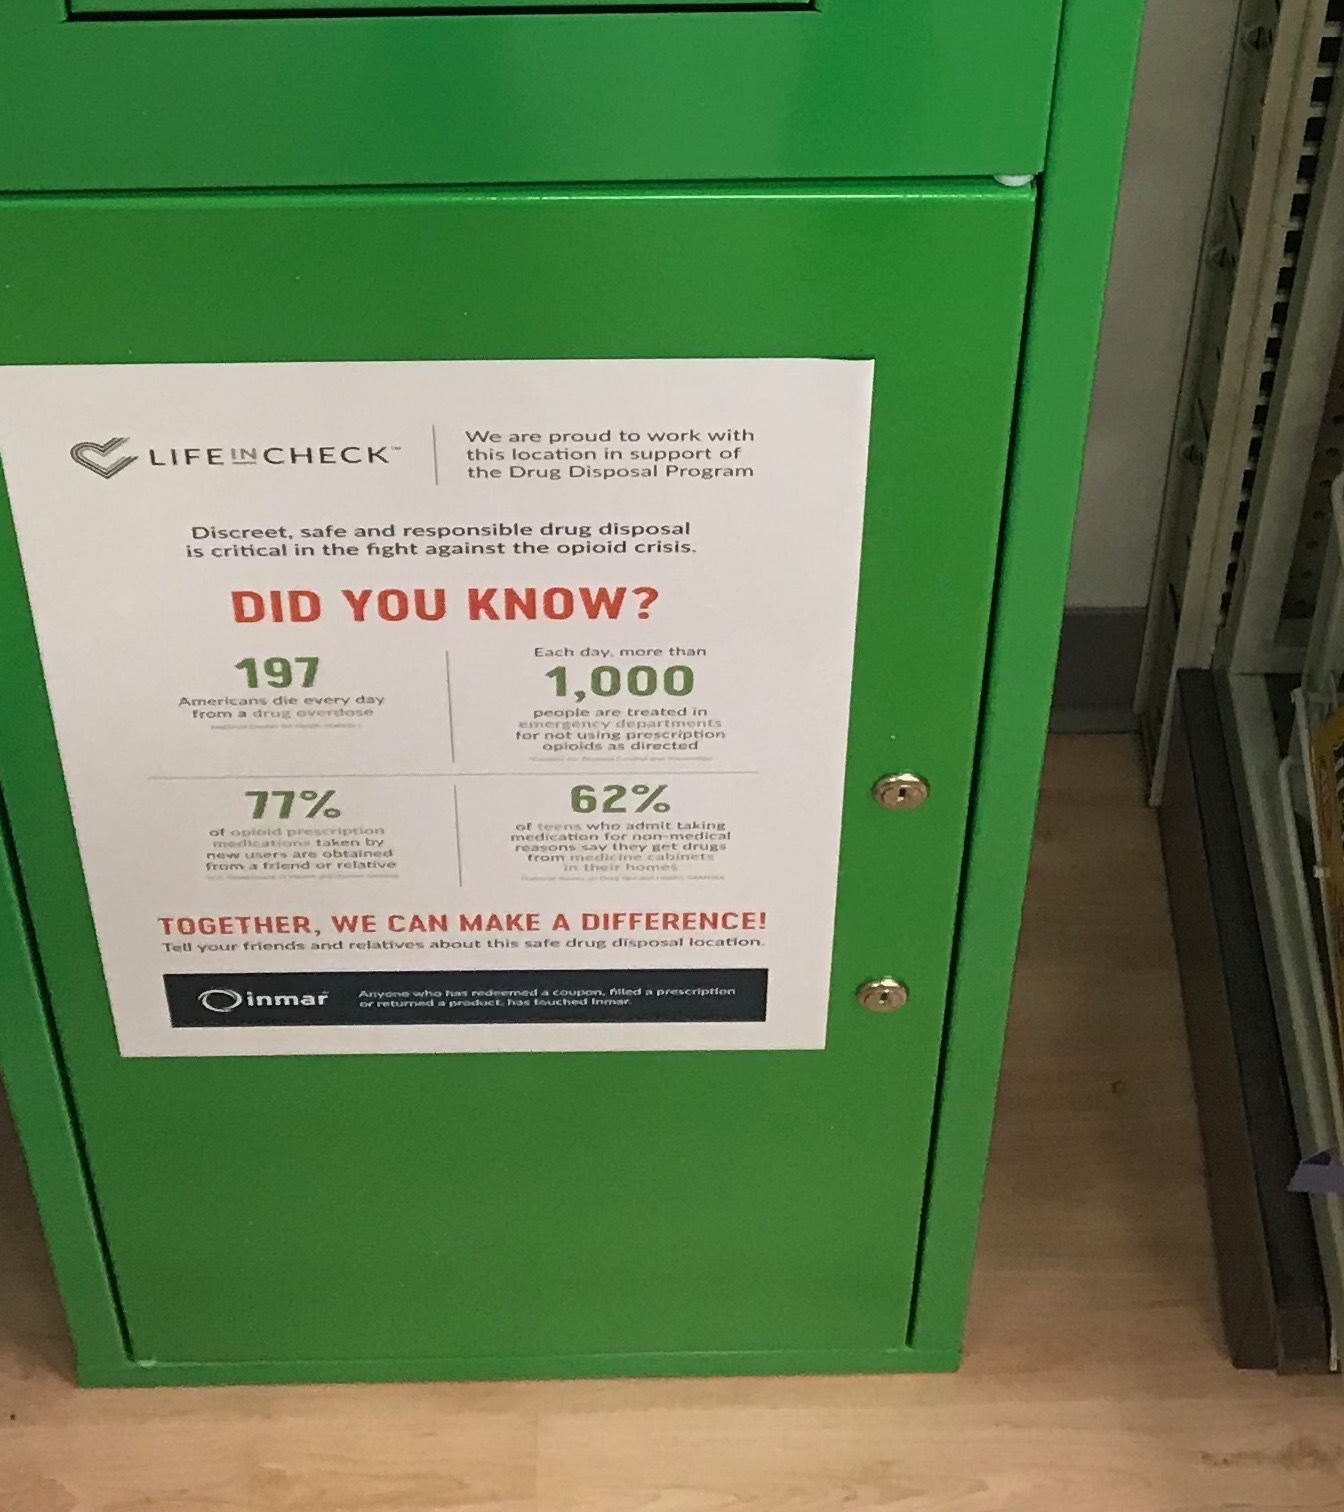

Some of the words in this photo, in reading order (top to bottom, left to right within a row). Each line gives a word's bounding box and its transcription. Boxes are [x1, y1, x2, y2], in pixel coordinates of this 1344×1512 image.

[464, 430, 503, 443] We
[508, 433, 542, 443] are
[549, 429, 612, 445] proud
[618, 429, 641, 443] to
[646, 428, 701, 442] work
[707, 428, 754, 442] with
[231, 589, 322, 624] DID
[340, 588, 447, 623] YOU
[467, 586, 659, 621] KNOW?
[534, 647, 575, 658] Each
[579, 646, 614, 659] day,
[619, 648, 663, 657] more
[668, 646, 707, 657] than
[234, 656, 320, 689] 197
[544, 664, 695, 704] 1,000
[244, 789, 342, 820] 77%
[570, 784, 671, 814] 62%
[156, 915, 321, 937] TOGETHER,
[330, 914, 377, 934] WE
[387, 913, 448, 933] CAN
[459, 912, 540, 932] MAKE
[551, 913, 571, 932] A
[581, 911, 767, 931] DIFFERENCE!
